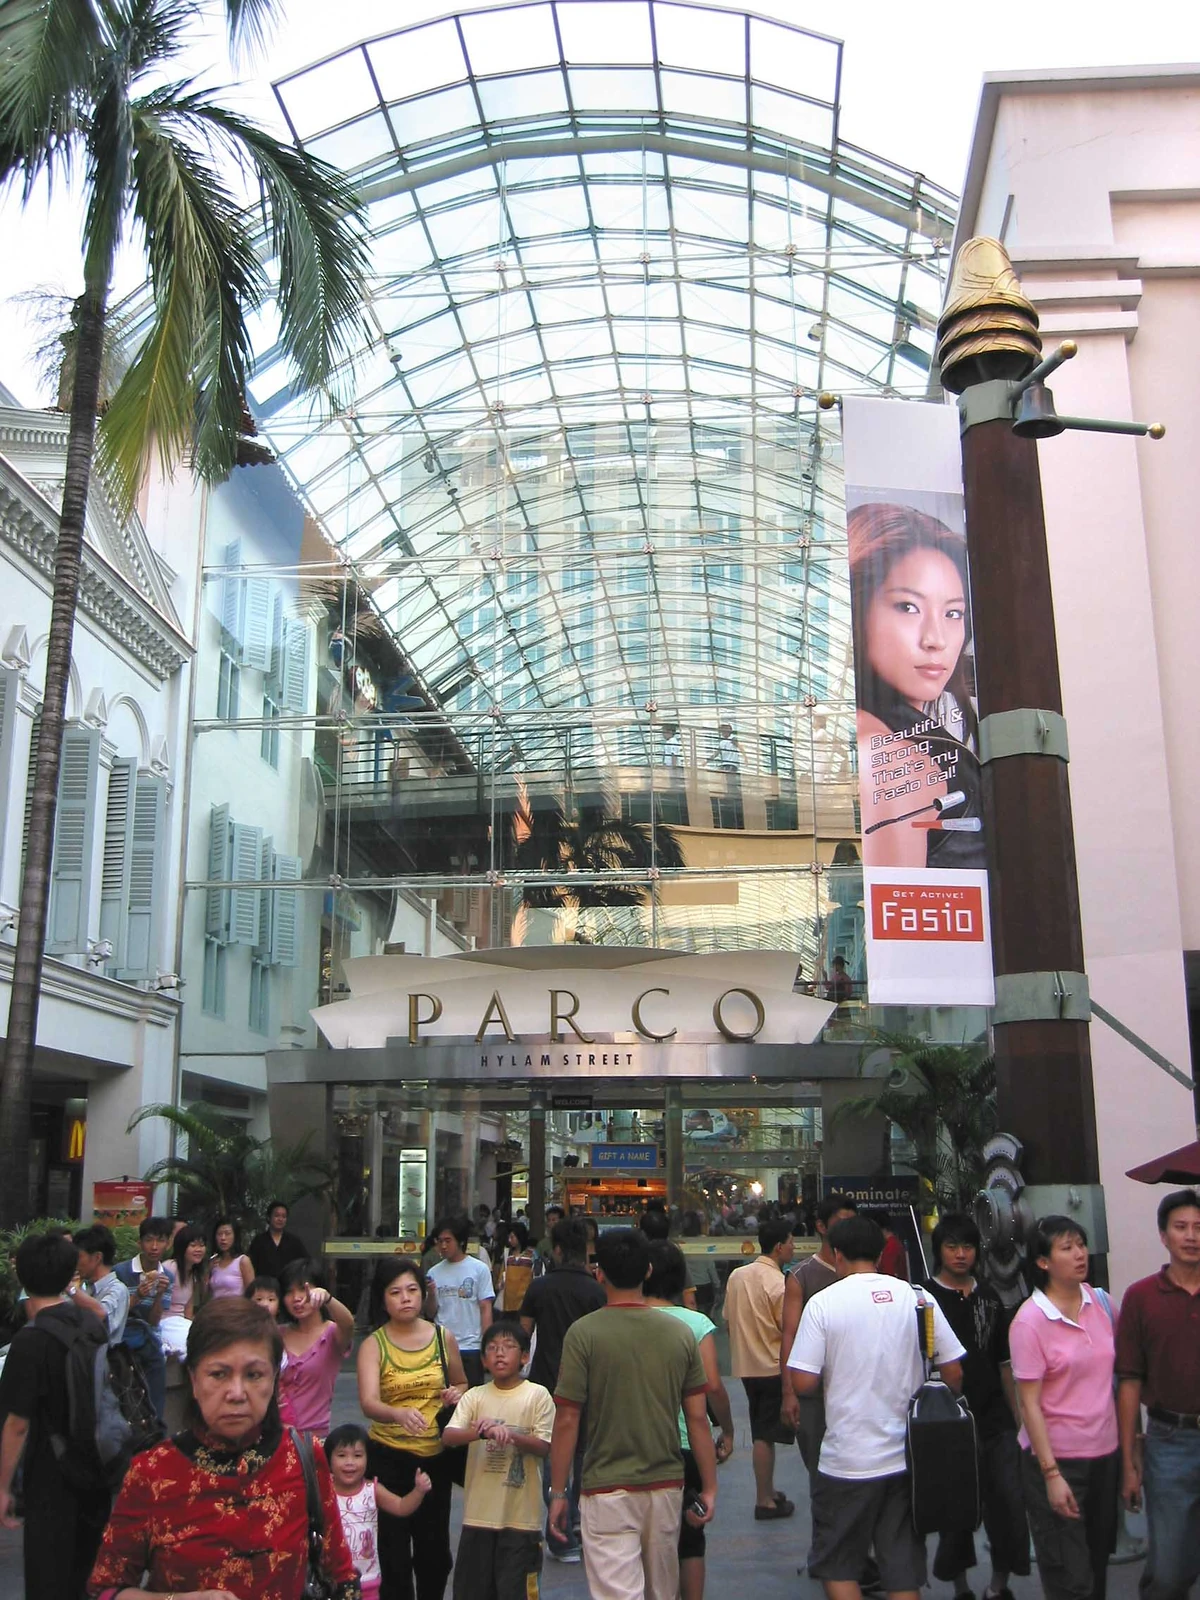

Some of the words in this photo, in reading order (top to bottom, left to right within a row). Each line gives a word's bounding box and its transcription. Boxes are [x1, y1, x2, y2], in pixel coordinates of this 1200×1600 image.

[871, 714, 945, 750] Beautiful
[951, 708, 963, 723] &
[871, 740, 933, 768] Strong.
[872, 760, 925, 785] That's
[931, 748, 959, 766] my
[873, 779, 921, 804] Fasio
[926, 764, 957, 787] Gal!
[882, 902, 972, 932] Fasio
[408, 988, 765, 1045] PARCO
[481, 1053, 551, 1067] HYLAM
[563, 1053, 633, 1066] STREET
[598, 1151, 617, 1161] GIFT
[619, 1152, 625, 1160] A
[627, 1151, 651, 1161] NAME
